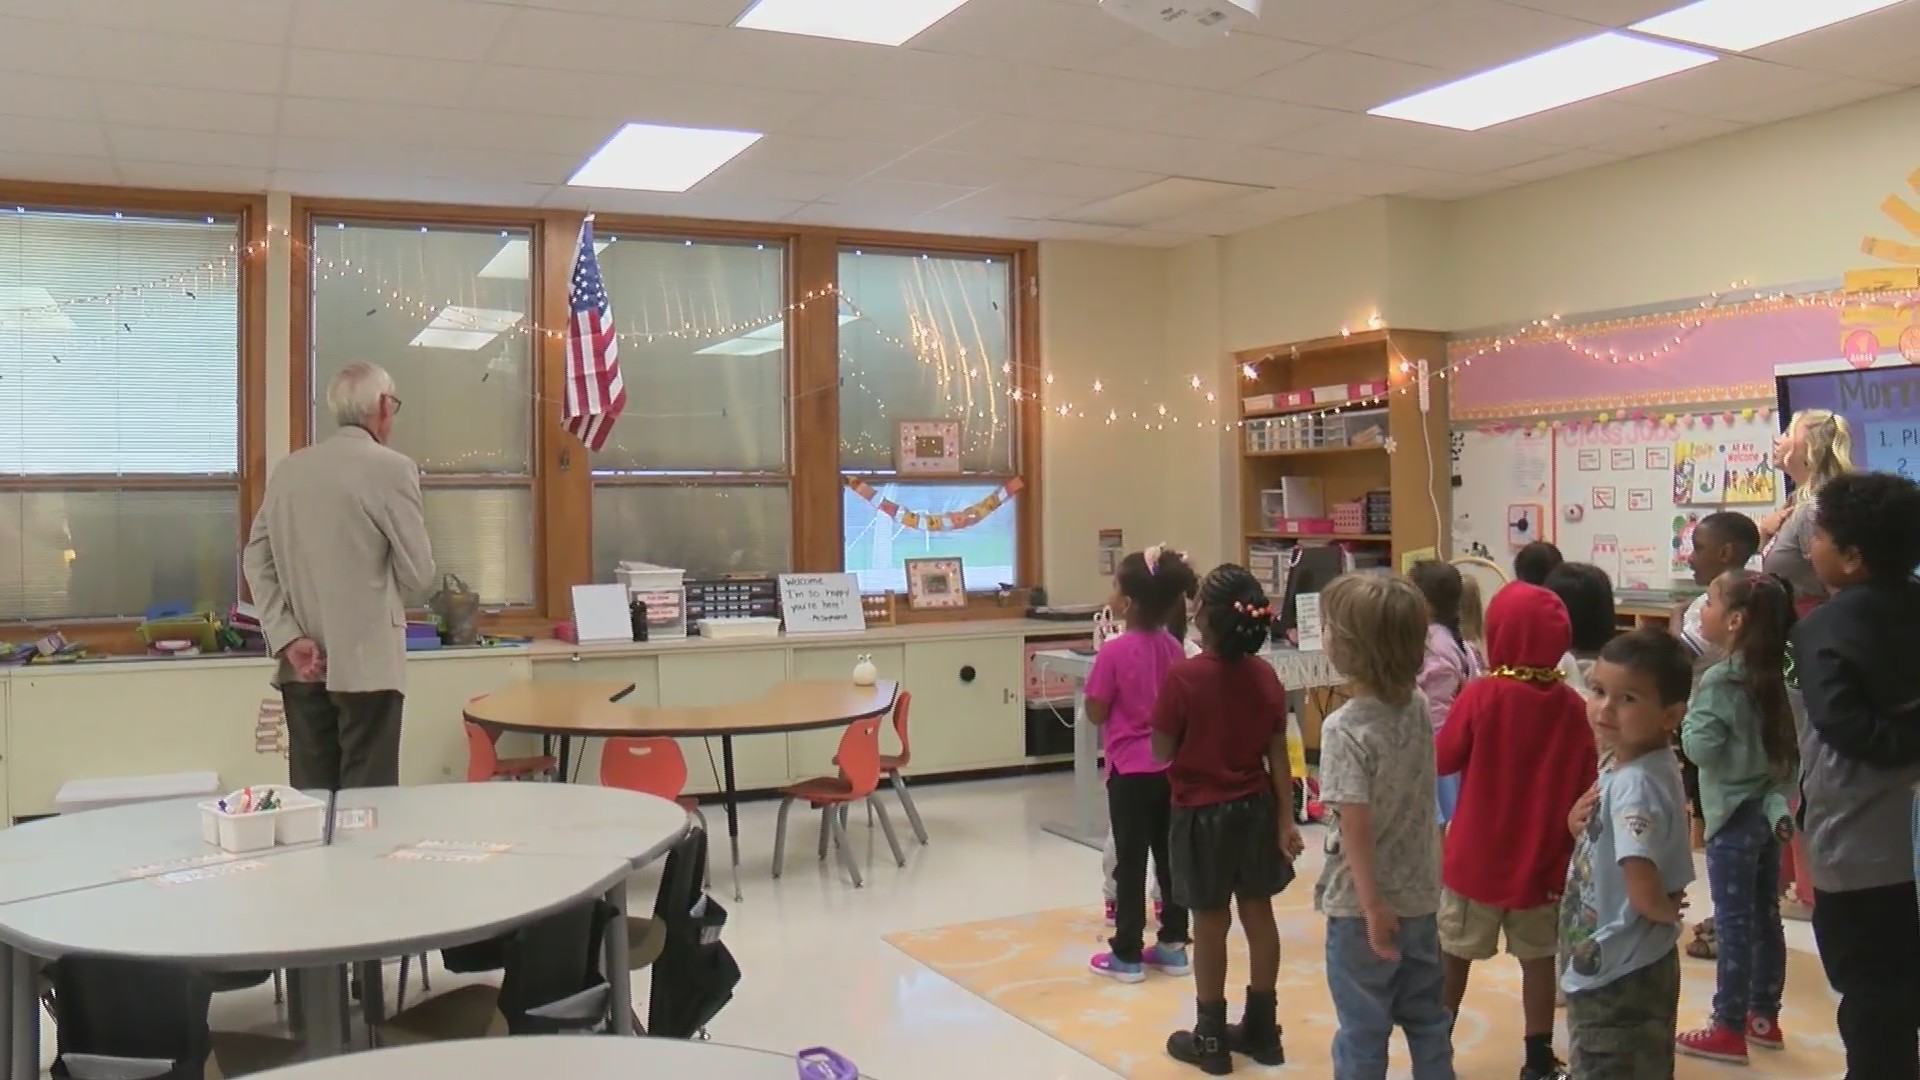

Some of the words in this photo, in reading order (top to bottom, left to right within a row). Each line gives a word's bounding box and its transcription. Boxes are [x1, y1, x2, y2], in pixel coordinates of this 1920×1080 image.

[1563, 422, 1622, 448] Class
[1880, 430, 1893, 447] 1.
[786, 590, 804, 599] I'm
